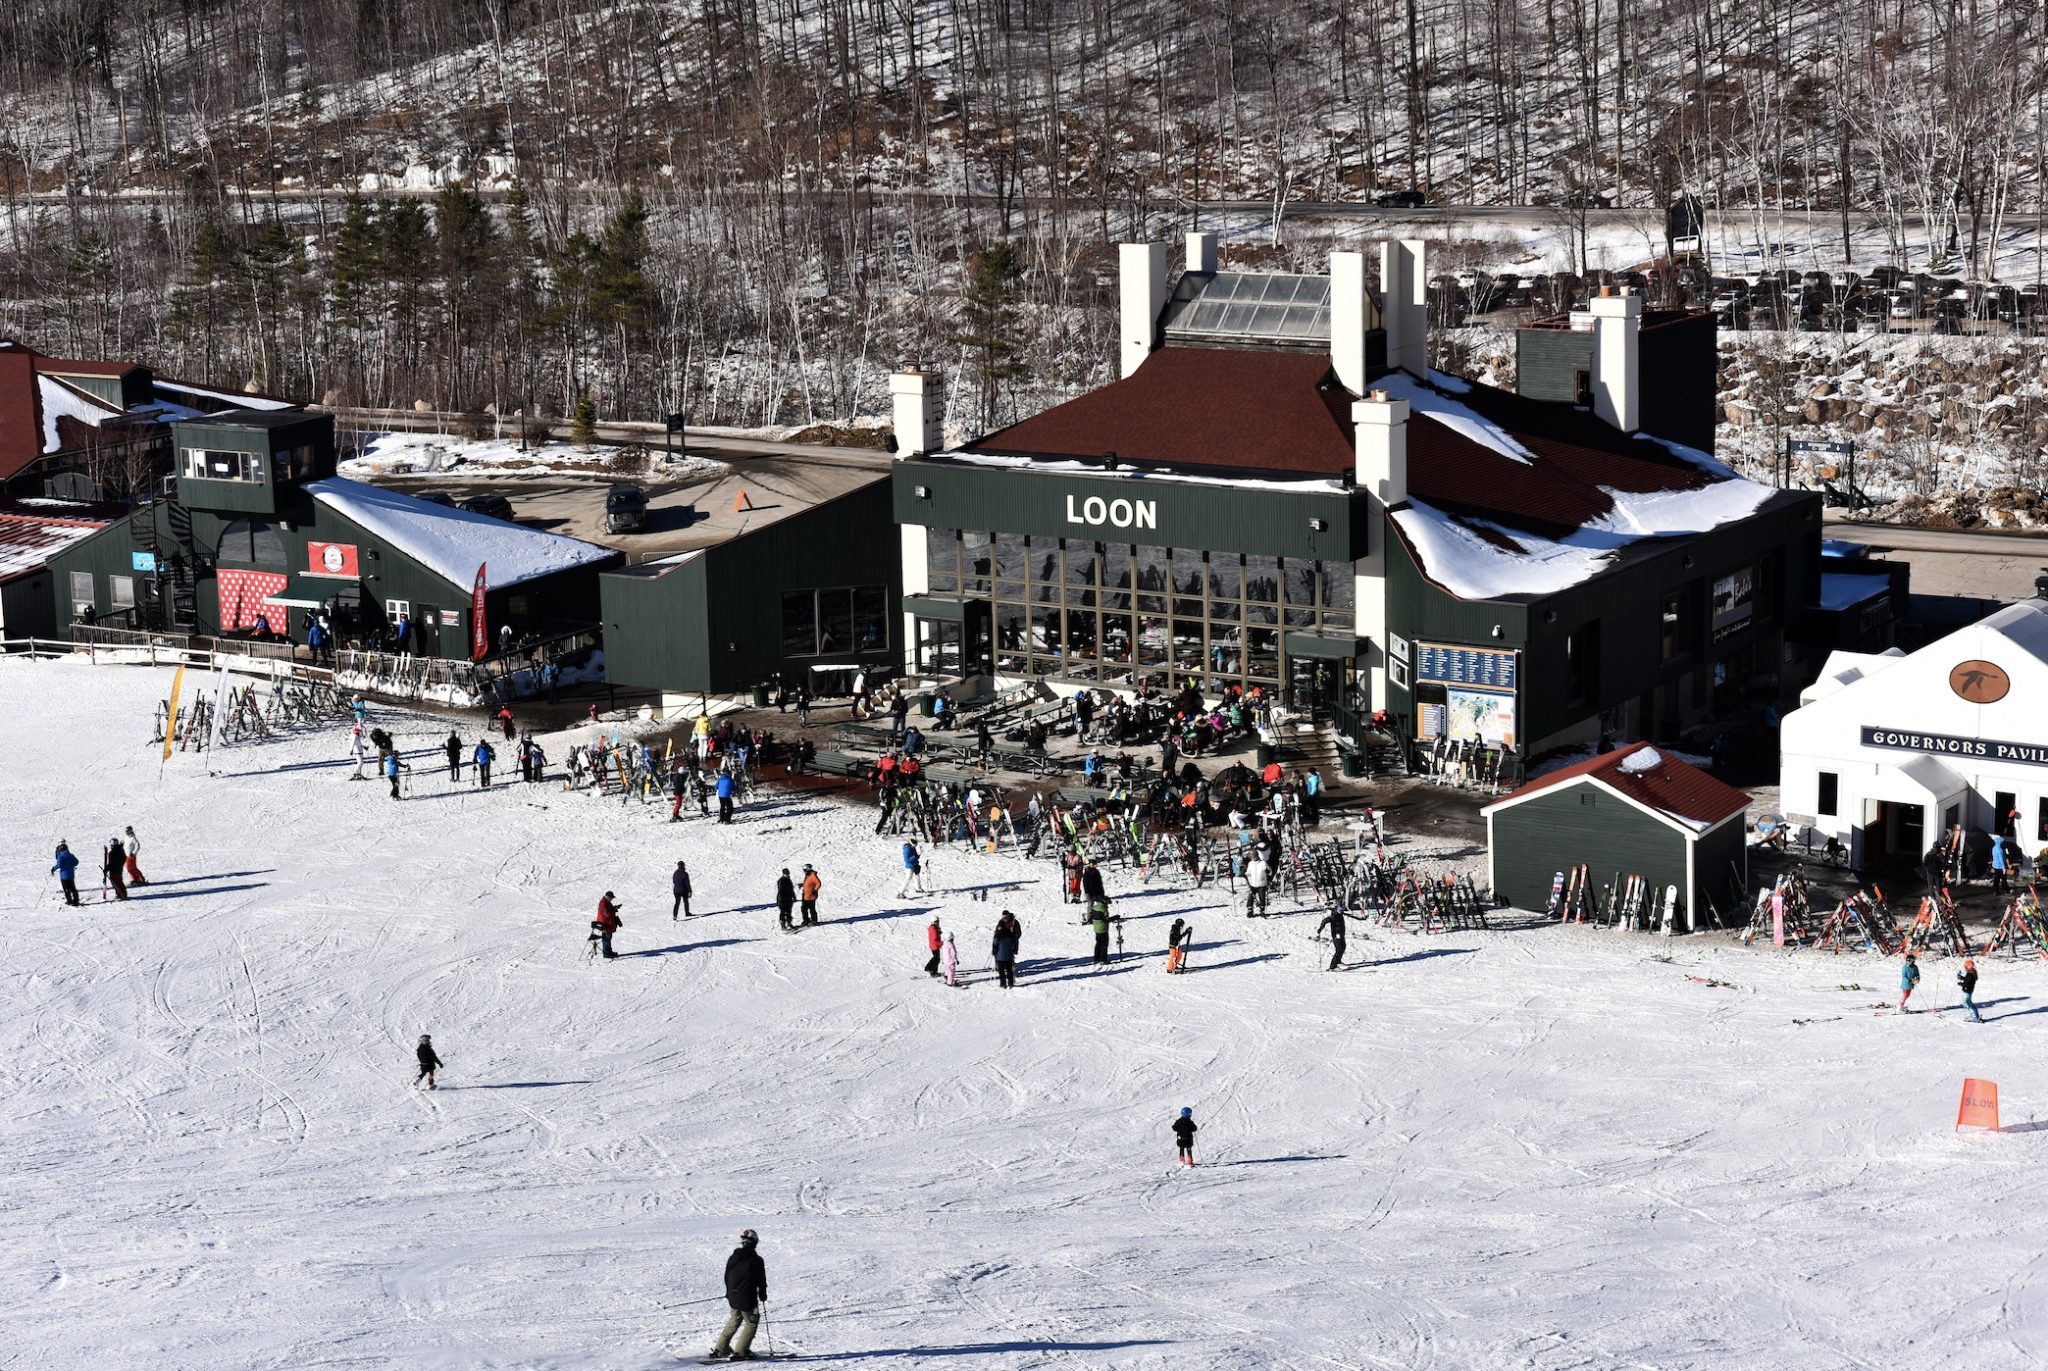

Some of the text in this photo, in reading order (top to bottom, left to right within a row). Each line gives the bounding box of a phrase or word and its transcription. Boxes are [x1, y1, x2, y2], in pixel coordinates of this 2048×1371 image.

[1066, 494, 1157, 529] LOON
[1873, 731, 2048, 763] GOVERNORS PAVIL
[1965, 1096, 1995, 1110] SLOW
